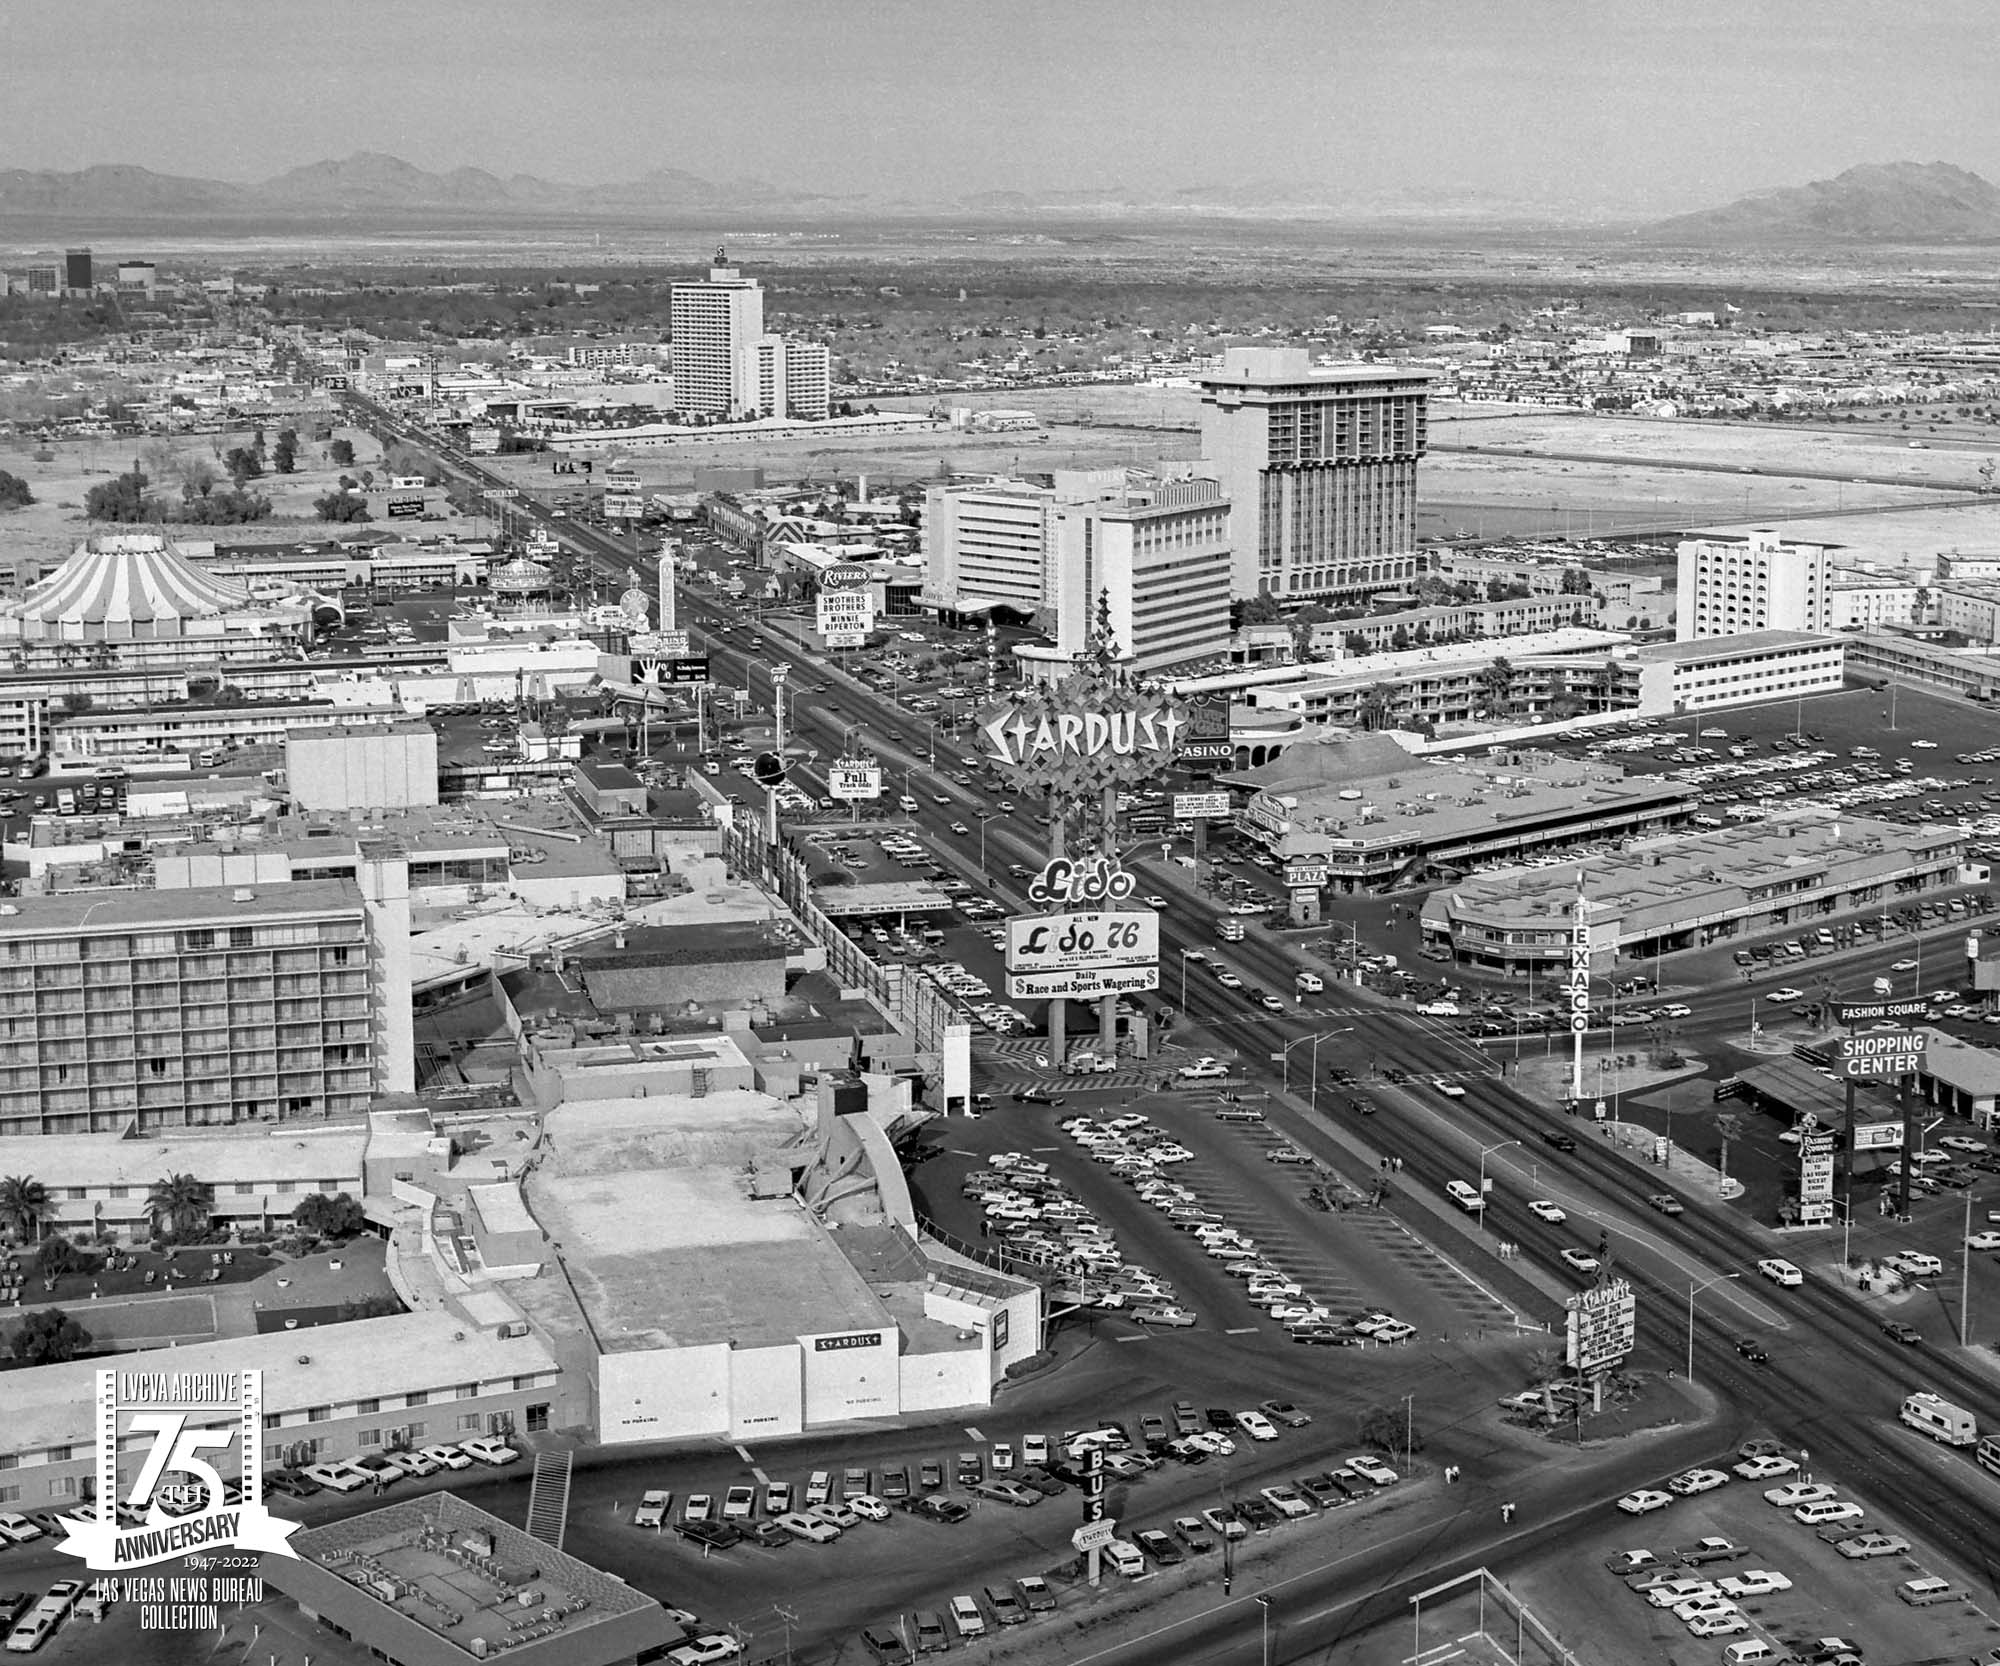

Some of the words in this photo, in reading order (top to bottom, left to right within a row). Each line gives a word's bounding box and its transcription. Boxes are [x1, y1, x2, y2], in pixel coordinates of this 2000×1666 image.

[824, 570, 867, 585] RIVIERA
[823, 596, 866, 604] SMOTHERS
[824, 603, 866, 612] BROTHERS
[825, 622, 865, 631] RIPERTON
[772, 675, 785, 683] 66
[985, 708, 1187, 766] STARDUST
[834, 758, 875, 769] STARDUST
[844, 772, 867, 782] Full
[1029, 858, 1135, 902] Lido
[1289, 871, 1326, 882] PLAZA
[1018, 923, 1095, 955] Lido
[1107, 922, 1141, 949] 76
[1075, 971, 1097, 980] Daily
[1572, 904, 1589, 1032] TEXACO
[1026, 983, 1049, 995] Race
[1051, 981, 1068, 993] and
[1070, 981, 1101, 993] Sports
[1102, 977, 1146, 990] Wagering
[1842, 1006, 1884, 1019] FASHION
[1887, 1003, 1928, 1016] SQUARE
[1843, 1035, 1923, 1056] SHOPPING
[1847, 1054, 1918, 1075] CENTER
[1583, 1281, 1631, 1309] STARDUST
[819, 1336, 880, 1349] STARDUST
[1091, 1450, 1103, 1520] BUS
